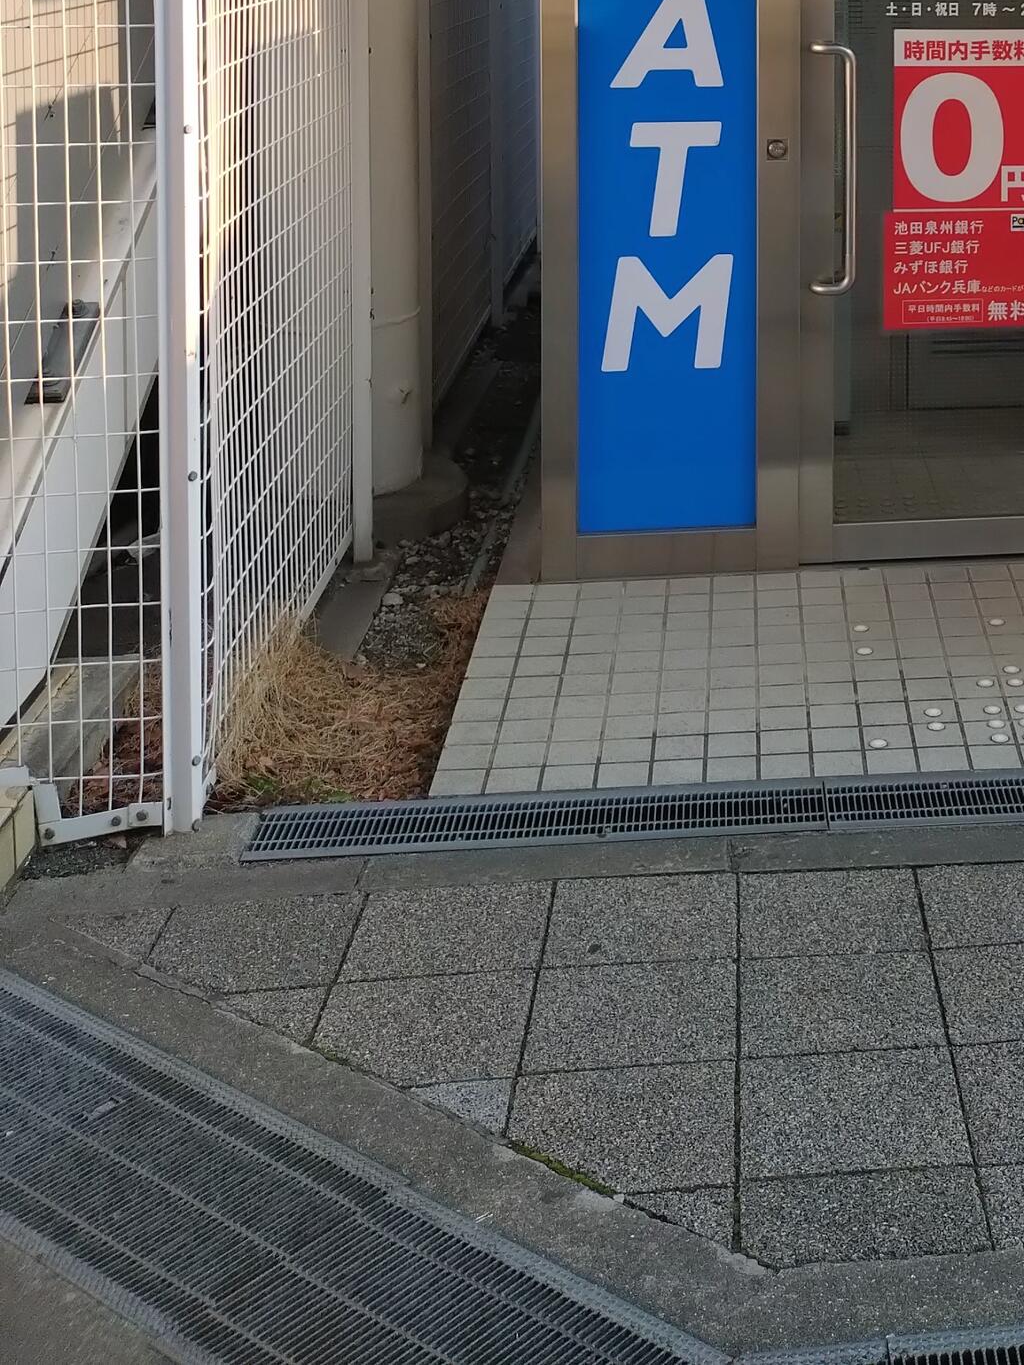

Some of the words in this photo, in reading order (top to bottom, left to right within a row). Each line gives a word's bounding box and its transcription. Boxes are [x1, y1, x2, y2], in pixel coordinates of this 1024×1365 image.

[894, 220, 984, 235] 池田泉州銀行
[894, 240, 980, 255] 三菱UFJ銀行
[893, 260, 969, 274] みずほ銀行
